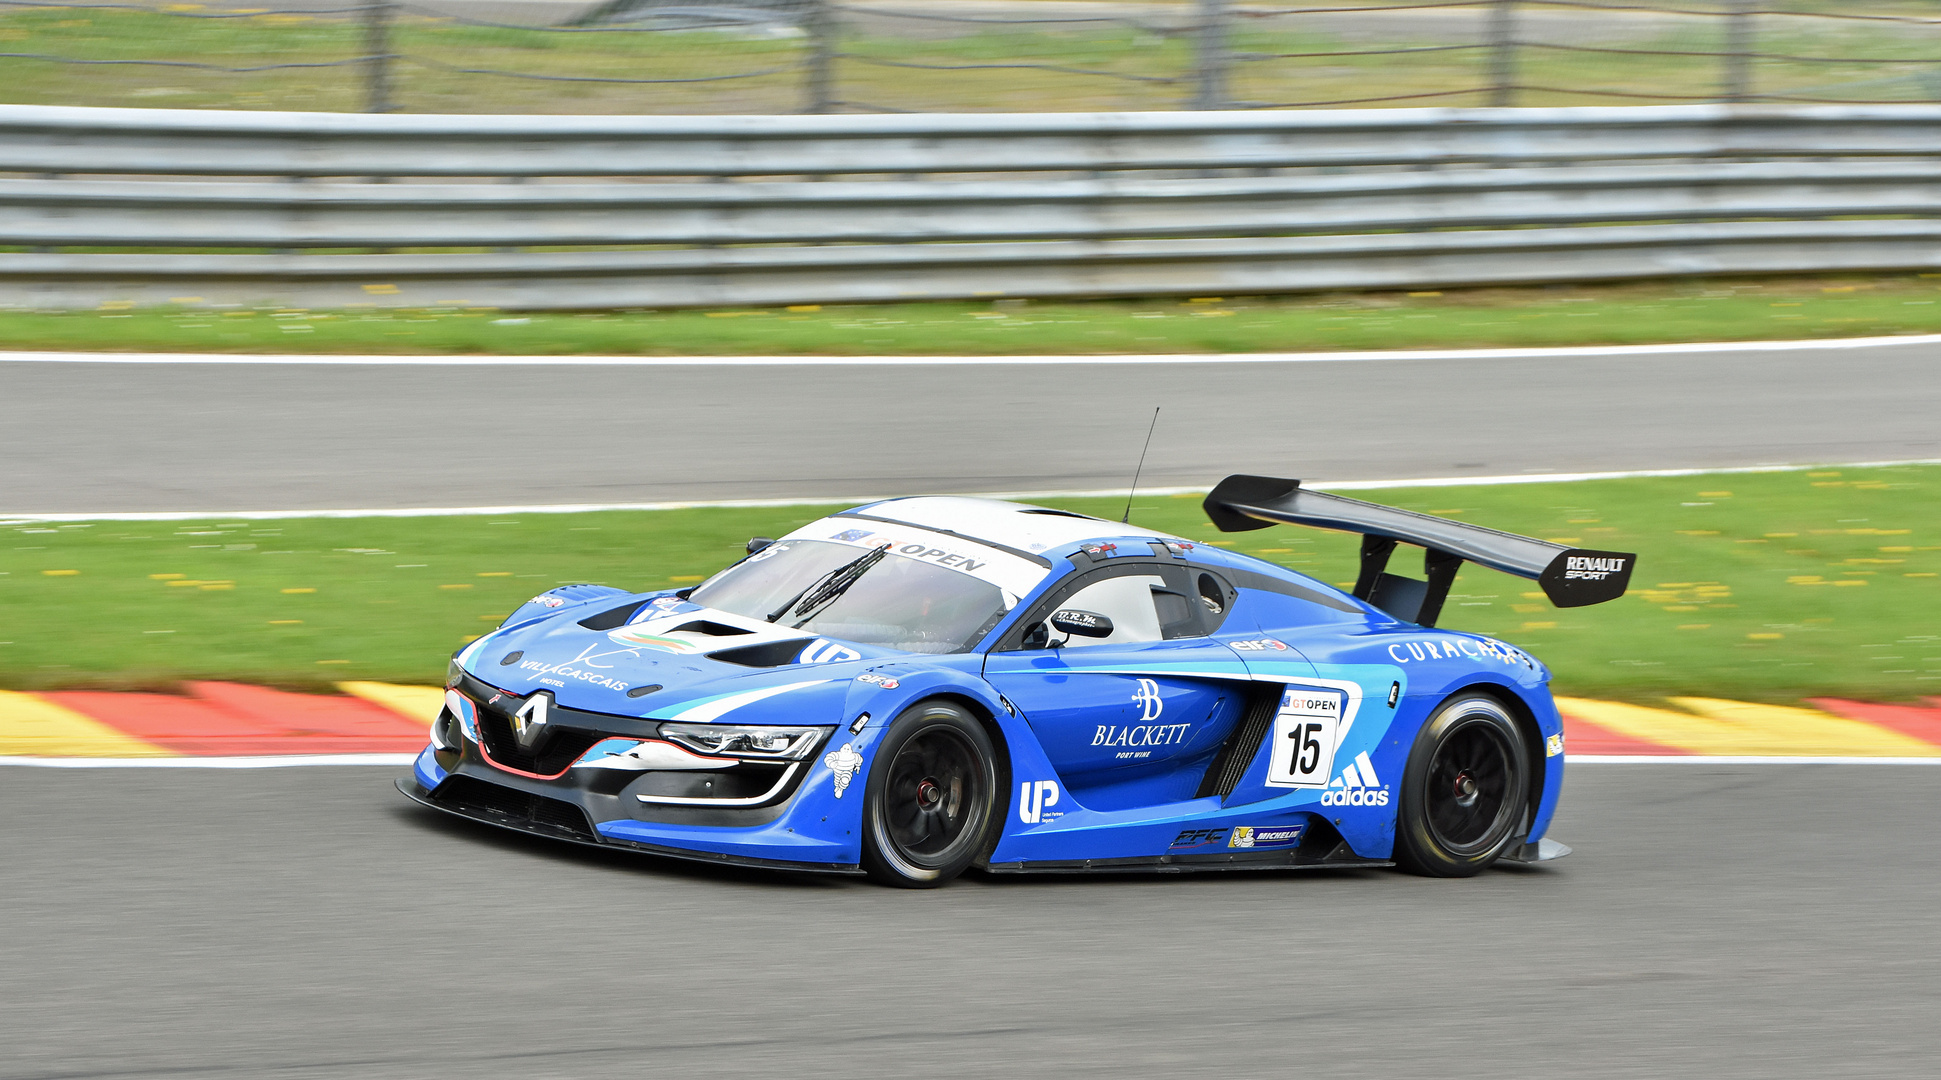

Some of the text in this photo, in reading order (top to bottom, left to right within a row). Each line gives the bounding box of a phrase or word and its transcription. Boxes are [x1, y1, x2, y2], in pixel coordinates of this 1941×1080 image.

[1566, 556, 1626, 572] RENAULT
[1565, 570, 1610, 580] SPORT
[1229, 640, 1265, 650] elf
[520, 660, 629, 691] VILLACASCAIS
[540, 677, 565, 688] HOTEL
[857, 674, 887, 684] elf
[1090, 723, 1191, 746] BLACKETT
[1288, 723, 1322, 775] 15
[1019, 780, 1060, 824] UP
[1321, 786, 1390, 806] adidas
[1256, 831, 1300, 840] MICHELIN
